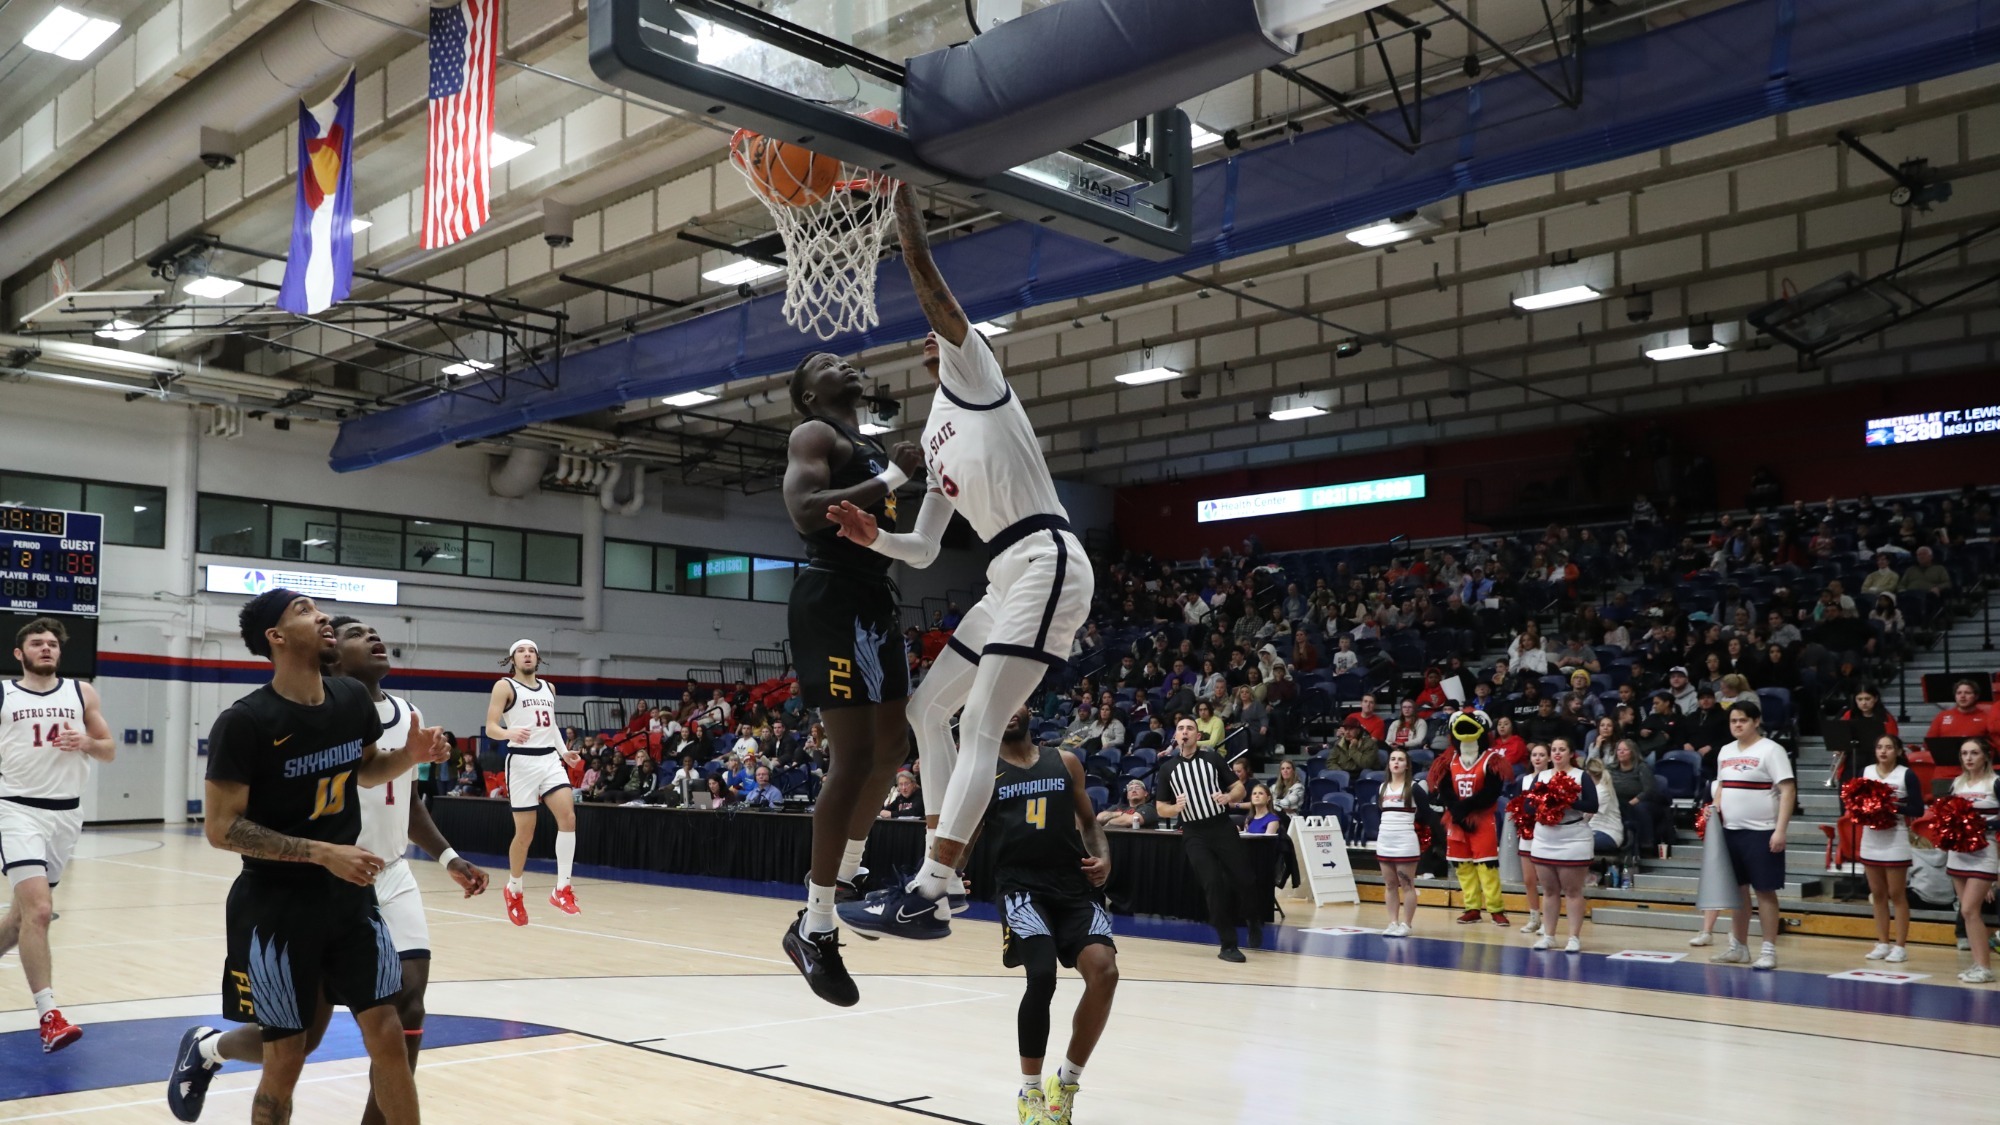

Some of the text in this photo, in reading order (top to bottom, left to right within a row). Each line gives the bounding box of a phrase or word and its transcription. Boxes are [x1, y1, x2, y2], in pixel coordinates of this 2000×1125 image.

[1943, 410, 1962, 422] FT.
[1893, 421, 1942, 443] 5280
[1944, 422, 1973, 436] MSU
[929, 421, 957, 456] STATE
[1220, 496, 1287, 511] Health Center
[13, 540, 41, 550] PERIOD
[60, 539, 96, 552] GUEST
[20, 551, 33, 569] 2
[0, 570, 52, 582] PLAYER FOUL
[73, 575, 98, 585] FOULS
[11, 599, 38, 609] MATCH
[72, 603, 97, 613] SCORE
[828, 655, 852, 699] FLC
[522, 699, 541, 708] METRO
[12, 707, 76, 722] METRO STATE
[535, 710, 551, 727] 13
[32, 723, 61, 748] 14
[283, 738, 364, 779] SKYHAWKS
[998, 777, 1065, 801] SKYHAWKS
[1026, 796, 1048, 830] 4
[231, 970, 255, 1015] FLC
